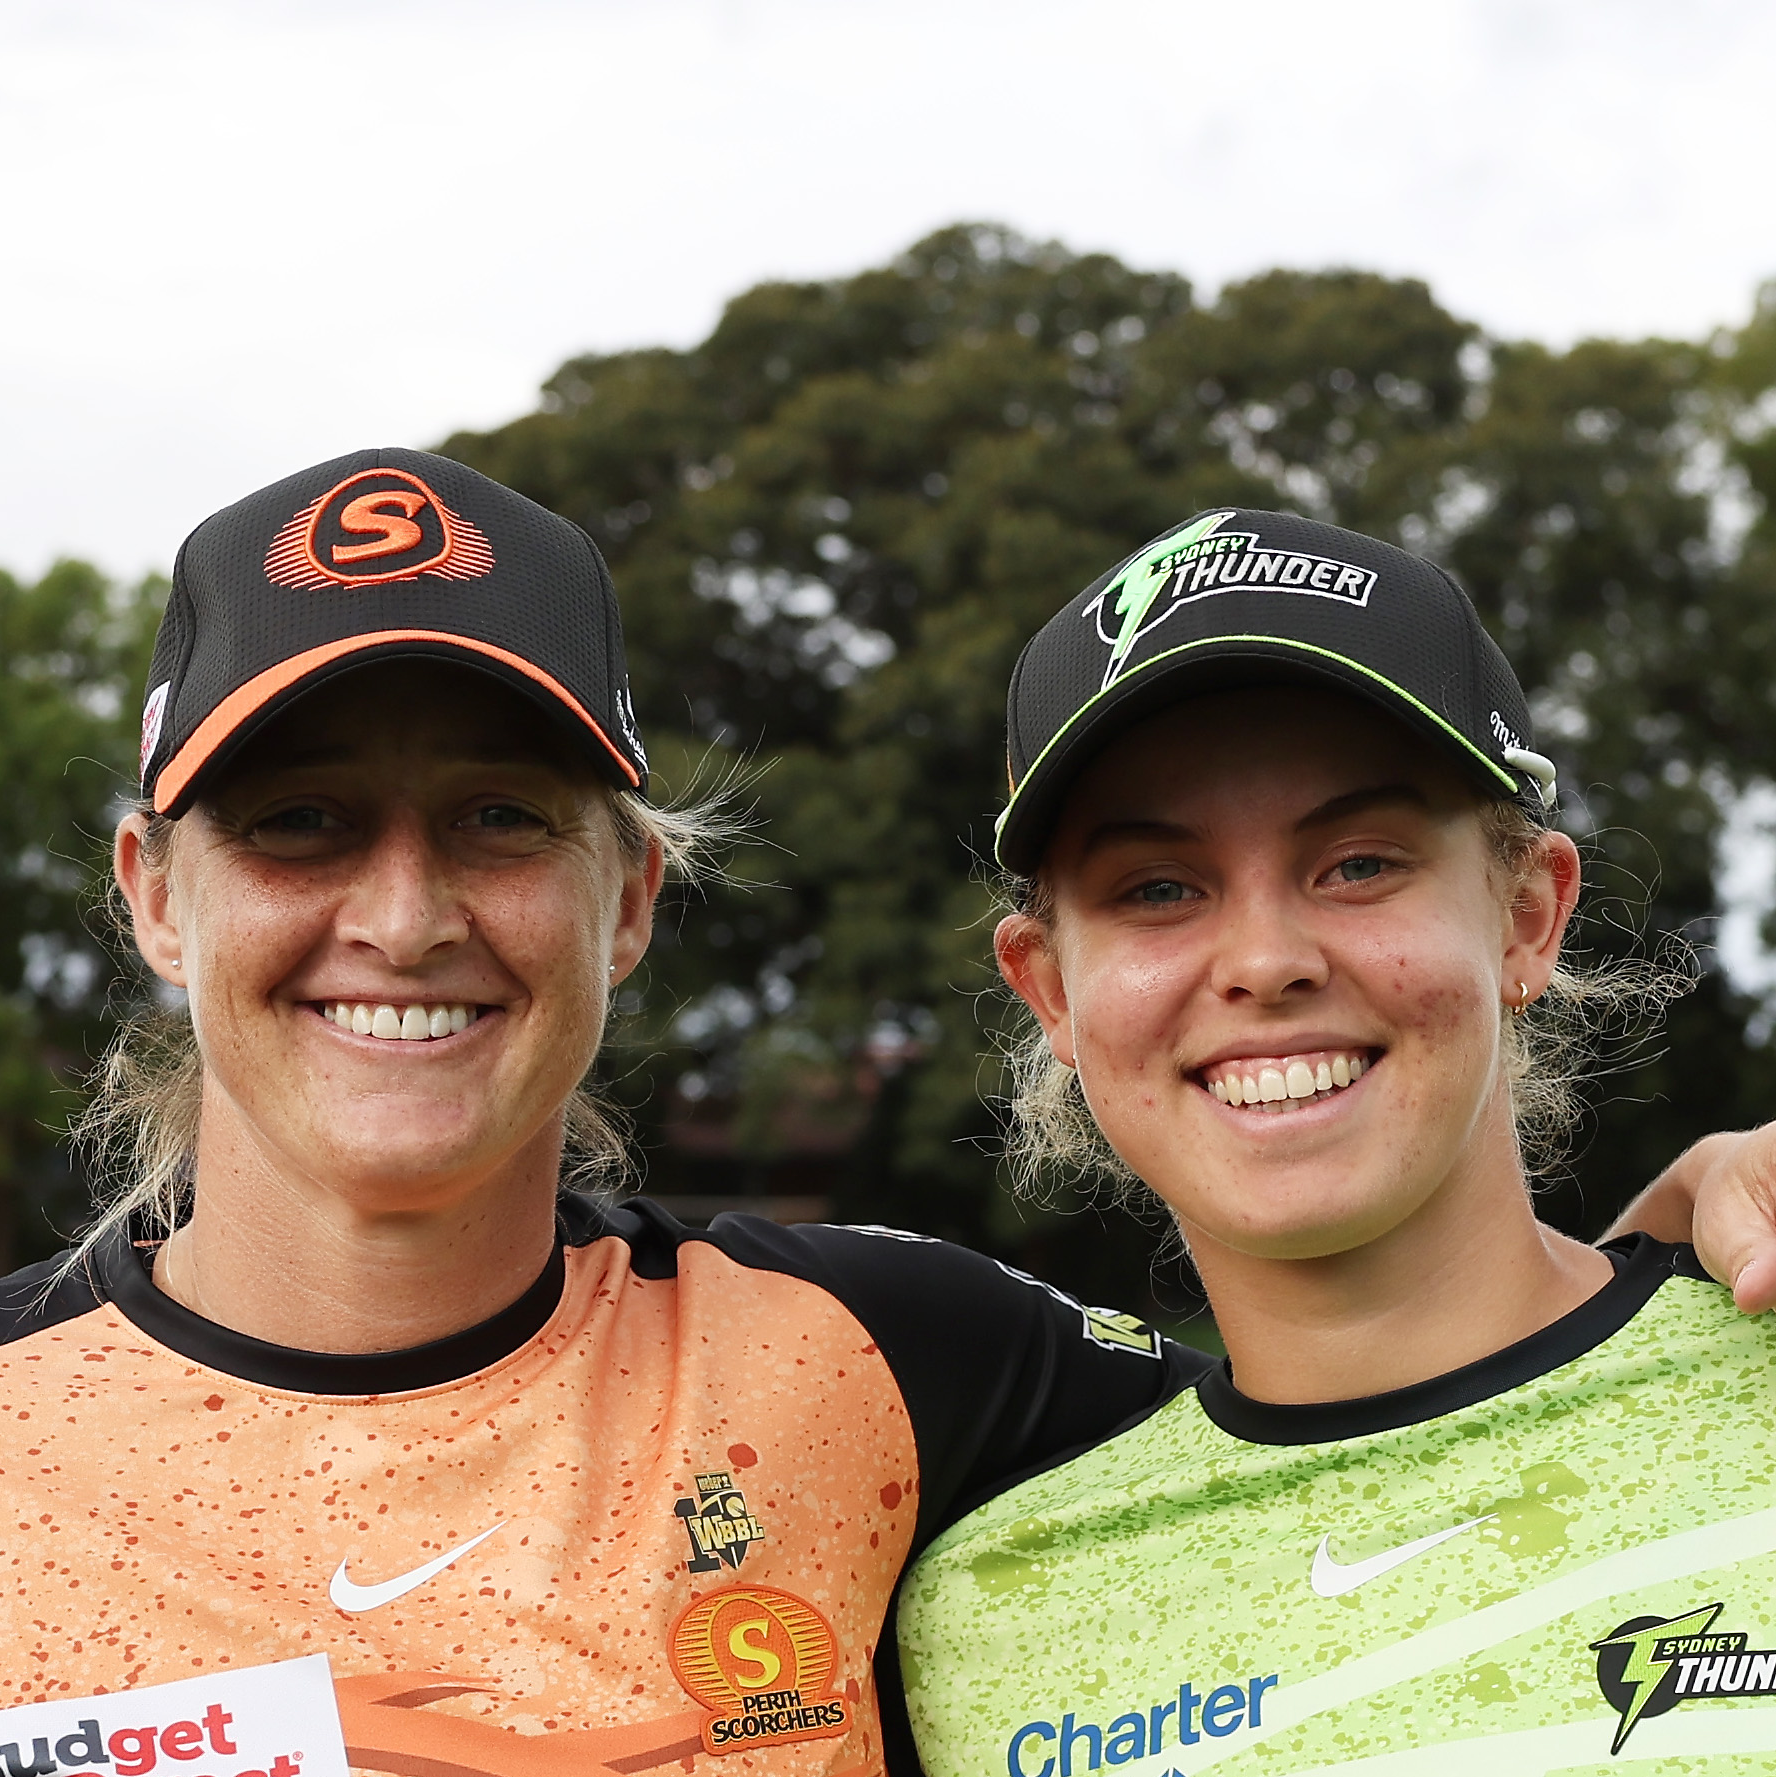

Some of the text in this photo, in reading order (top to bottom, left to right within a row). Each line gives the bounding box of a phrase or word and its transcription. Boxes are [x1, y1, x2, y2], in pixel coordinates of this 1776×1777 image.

[331, 490, 427, 565] S
[1159, 537, 1245, 574] SYDNEY
[1171, 552, 1366, 598] THUNDER
[690, 1514, 765, 1551] WBBL
[728, 1618, 782, 1689] S
[1662, 1635, 1742, 1656] SYDNEY
[742, 1689, 802, 1714] PERTH
[711, 1701, 845, 1743] SCORCHERS
